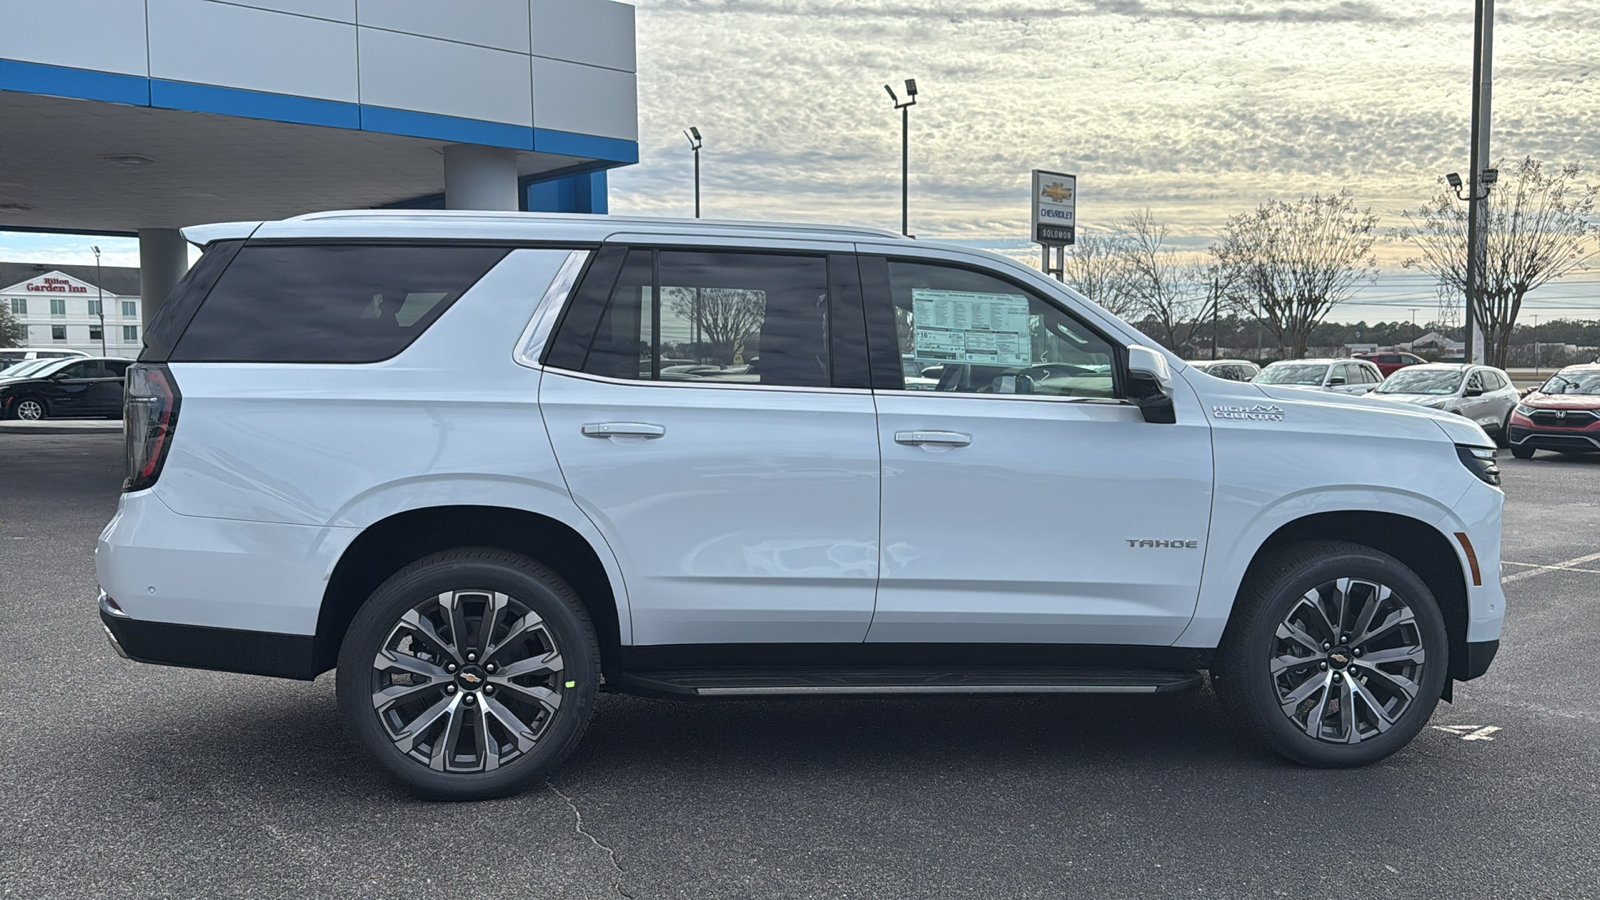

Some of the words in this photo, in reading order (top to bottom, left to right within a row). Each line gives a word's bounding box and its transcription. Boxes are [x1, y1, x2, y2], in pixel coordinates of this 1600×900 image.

[1041, 208, 1072, 219] CHEVROLET
[1042, 229, 1072, 239] SOLOMON
[26, 283, 66, 292] Garden
[68, 285, 87, 293] Inn
[1214, 412, 1285, 421] COUNTRY
[1126, 539, 1198, 548] TAHOE
